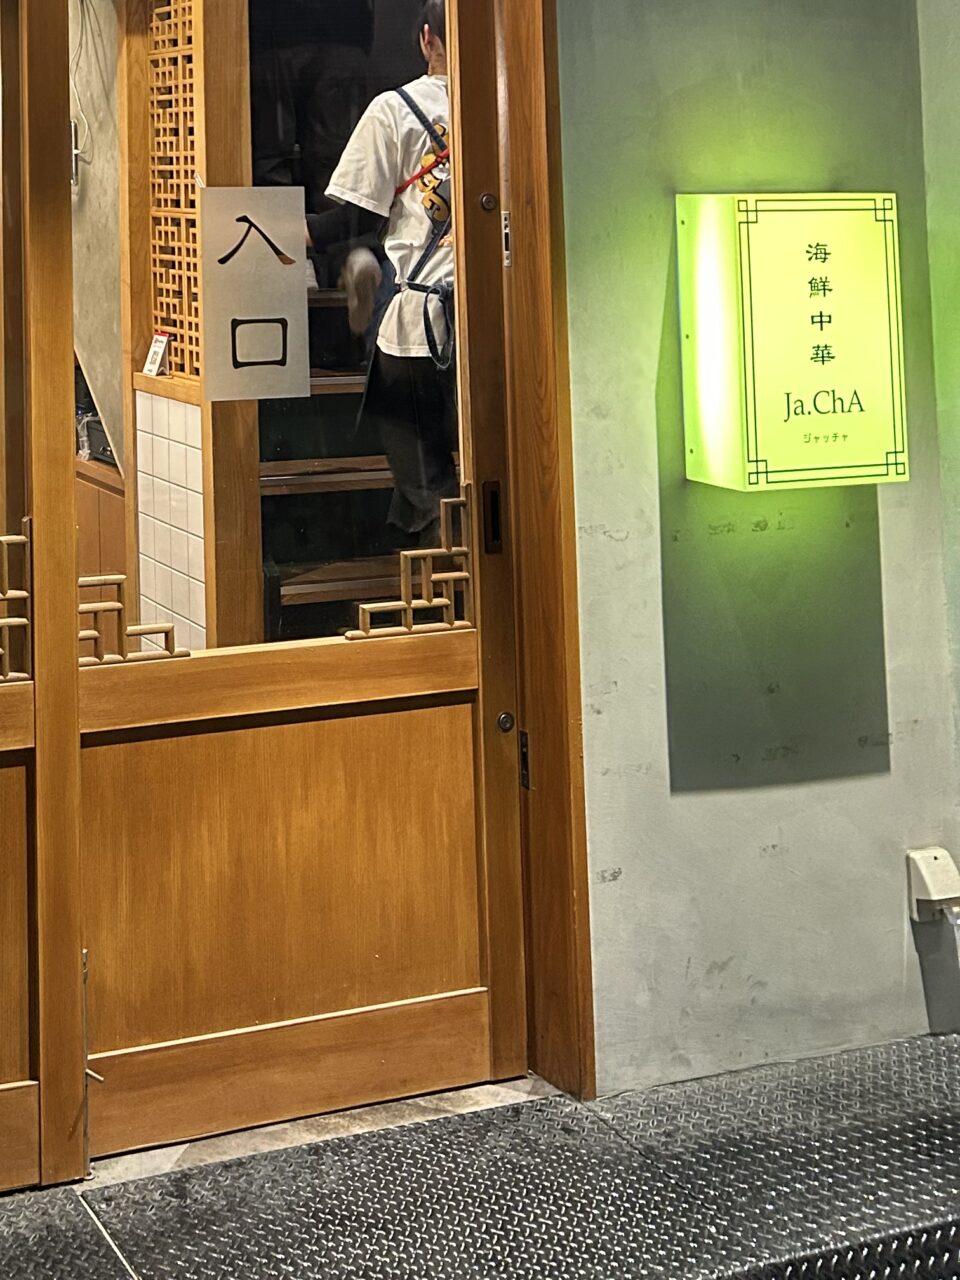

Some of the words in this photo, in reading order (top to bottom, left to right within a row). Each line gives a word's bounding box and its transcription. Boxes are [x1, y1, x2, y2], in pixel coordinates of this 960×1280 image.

[217, 215, 296, 370] 入口
[806, 242, 836, 366] 海鮮中華
[784, 389, 866, 423] Ja.ChA
[803, 432, 849, 444] ジャッチャ
